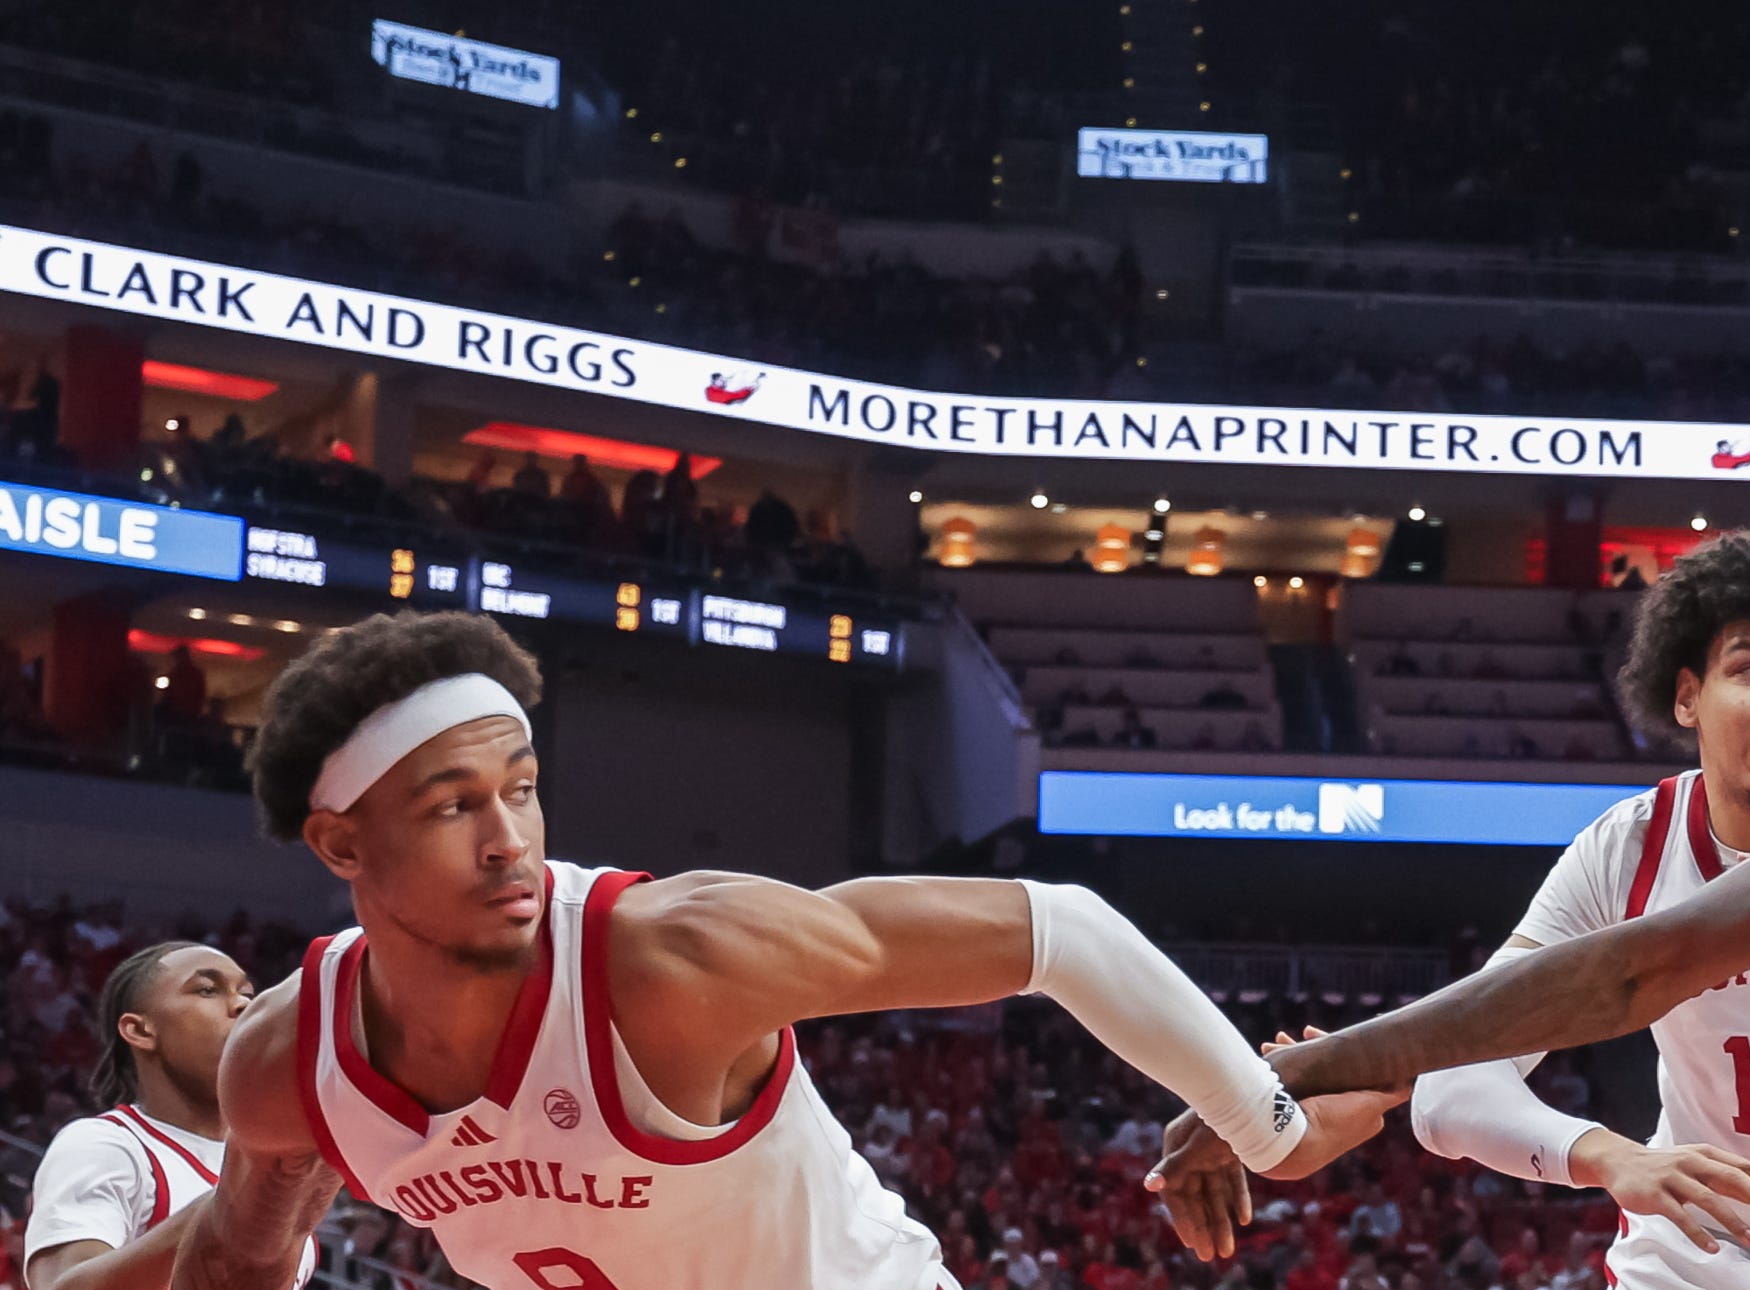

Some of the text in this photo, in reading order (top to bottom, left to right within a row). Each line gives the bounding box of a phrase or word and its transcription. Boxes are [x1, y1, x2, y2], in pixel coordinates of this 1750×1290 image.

[1097, 138, 1249, 160] Stock Yards
[34, 245, 638, 388] CLARK AND RIGGS
[806, 382, 1645, 468] MORETHANAPRINTER.COM
[1173, 801, 1234, 831] Look
[1236, 802, 1273, 832] for
[1274, 803, 1316, 833] the
